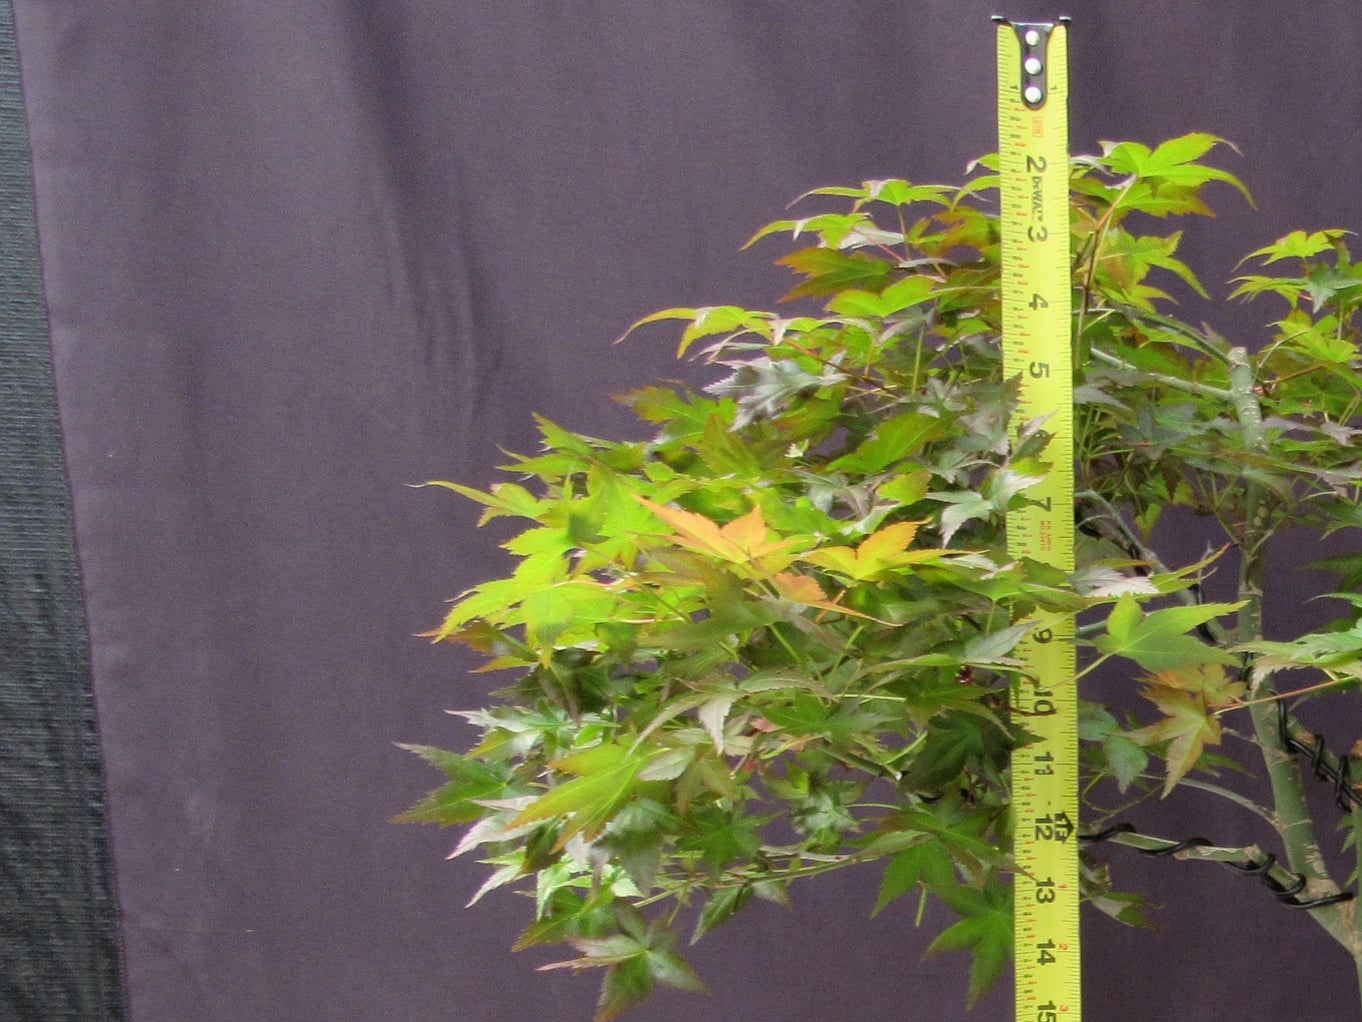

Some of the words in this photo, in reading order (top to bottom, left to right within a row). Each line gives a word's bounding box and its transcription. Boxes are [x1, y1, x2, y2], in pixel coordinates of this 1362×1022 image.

[1026, 155, 1046, 173] 2
[1027, 226, 1048, 242] 3
[1028, 293, 1049, 310] 4
[1029, 361, 1050, 379] 5
[1030, 496, 1051, 512] 7
[1033, 628, 1053, 644] 9
[1034, 688, 1053, 713] 10
[1034, 751, 1054, 775] 11
[1035, 813, 1053, 841] 12
[1036, 877, 1055, 904] 13
[1037, 938, 1056, 966] 14
